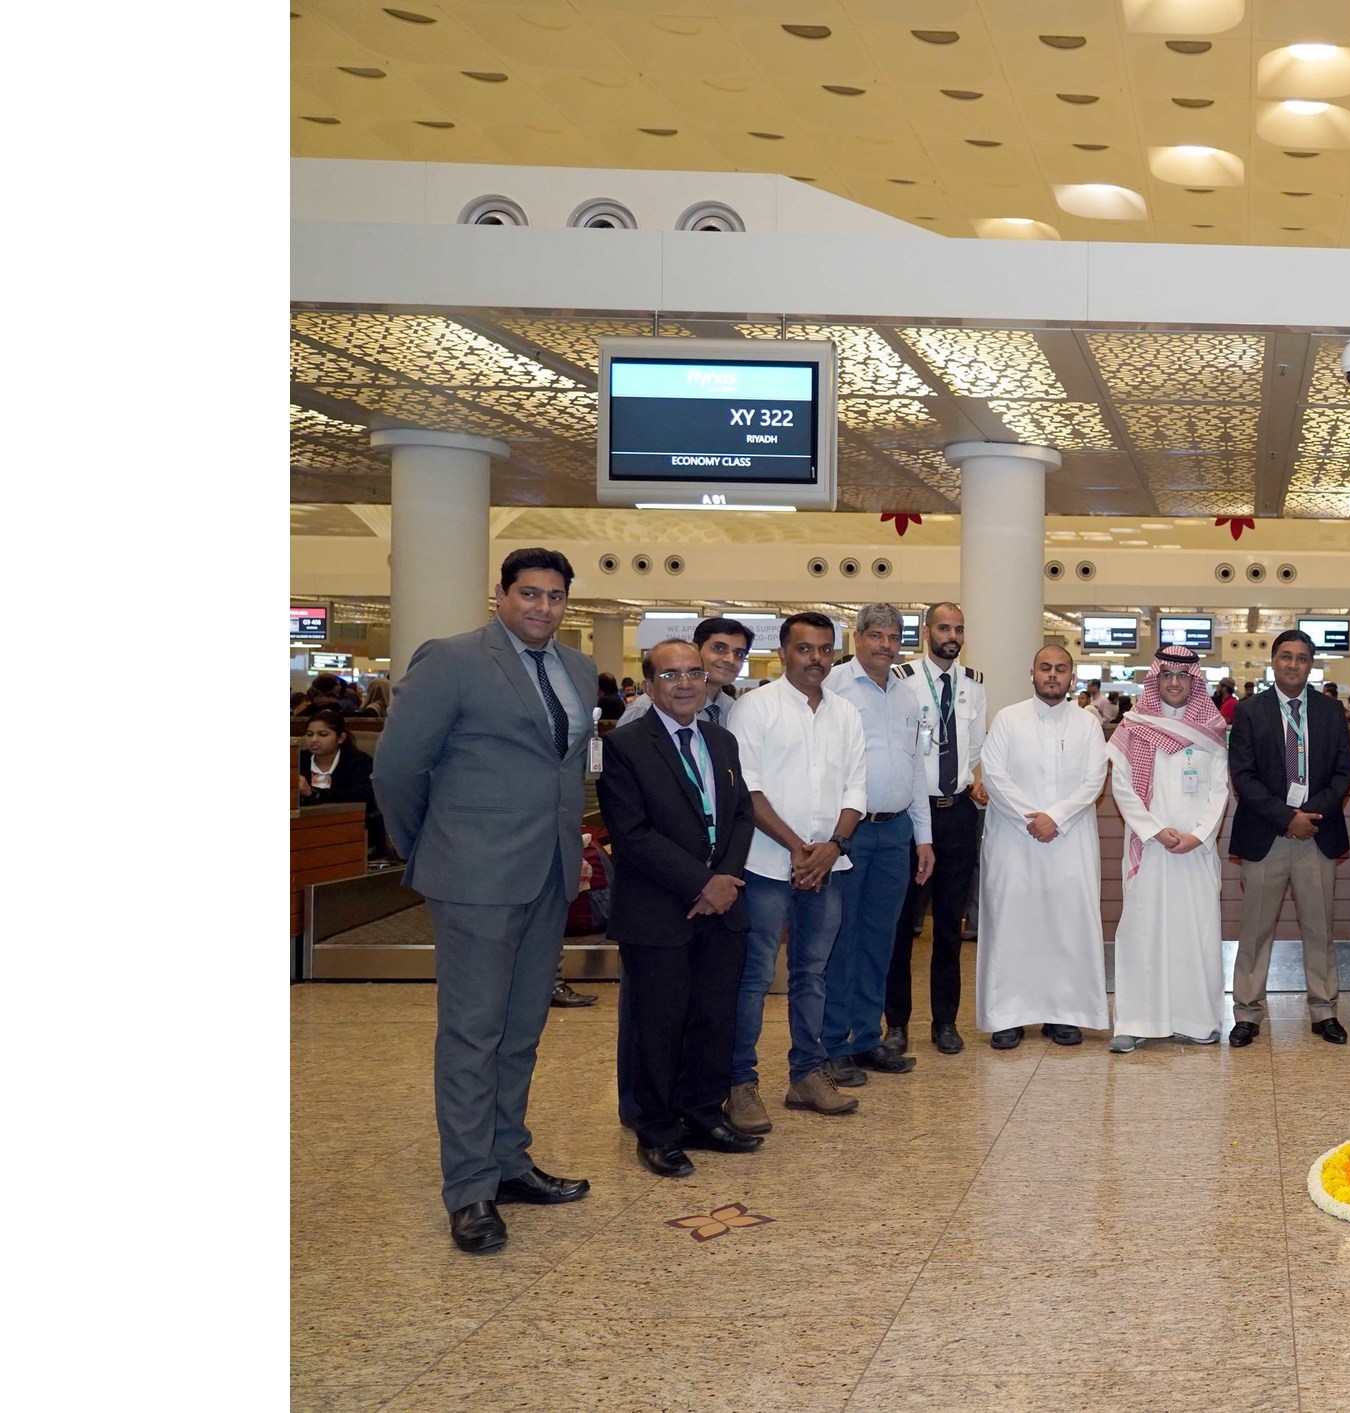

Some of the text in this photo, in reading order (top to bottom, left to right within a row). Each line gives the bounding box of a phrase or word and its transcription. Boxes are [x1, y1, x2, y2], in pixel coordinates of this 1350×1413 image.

[730, 408, 794, 427] XY 322
[746, 434, 778, 444] RIYADH
[671, 456, 751, 467] ECONOMY CLASS
[702, 494, 712, 505] A
[667, 625, 679, 633] WE
